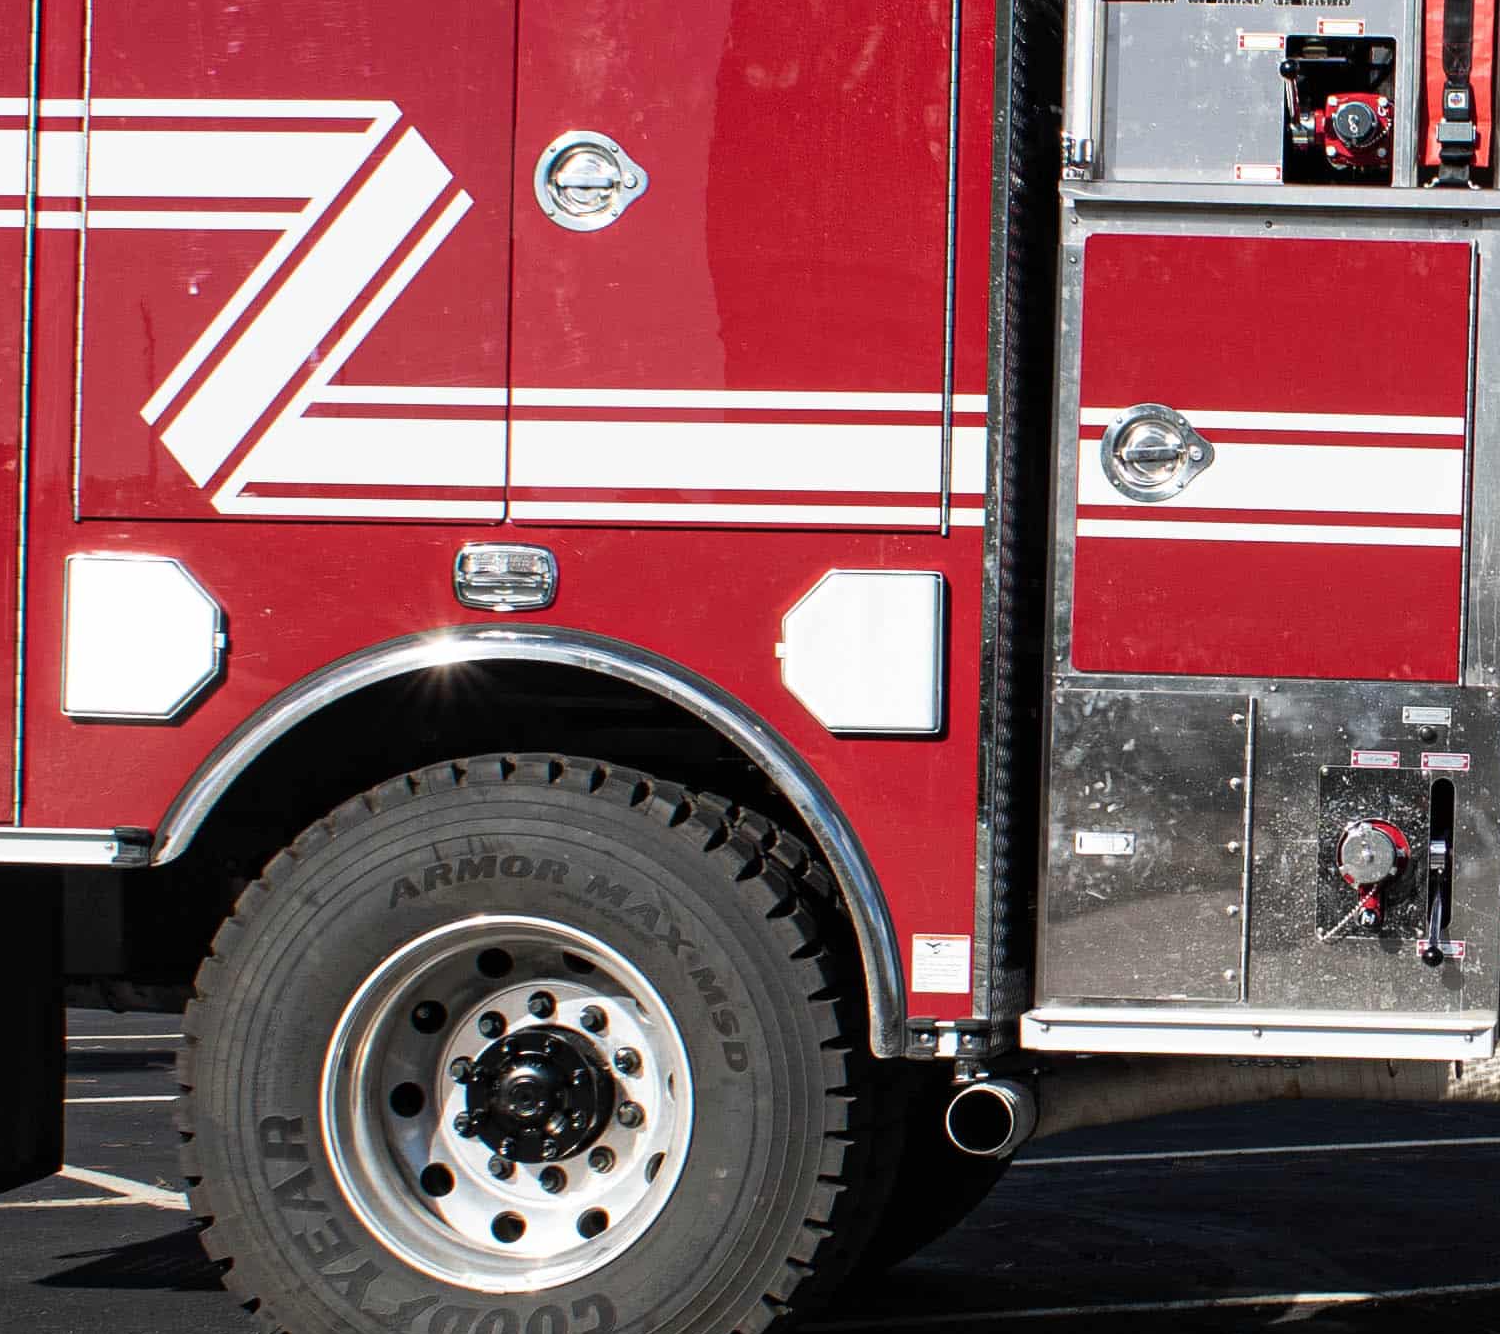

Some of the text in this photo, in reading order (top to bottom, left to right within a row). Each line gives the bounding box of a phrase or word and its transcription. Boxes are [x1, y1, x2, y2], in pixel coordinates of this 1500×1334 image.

[389, 855, 570, 909] ARMOR
[586, 874, 696, 956] MAX
[687, 967, 750, 1073] MSD
